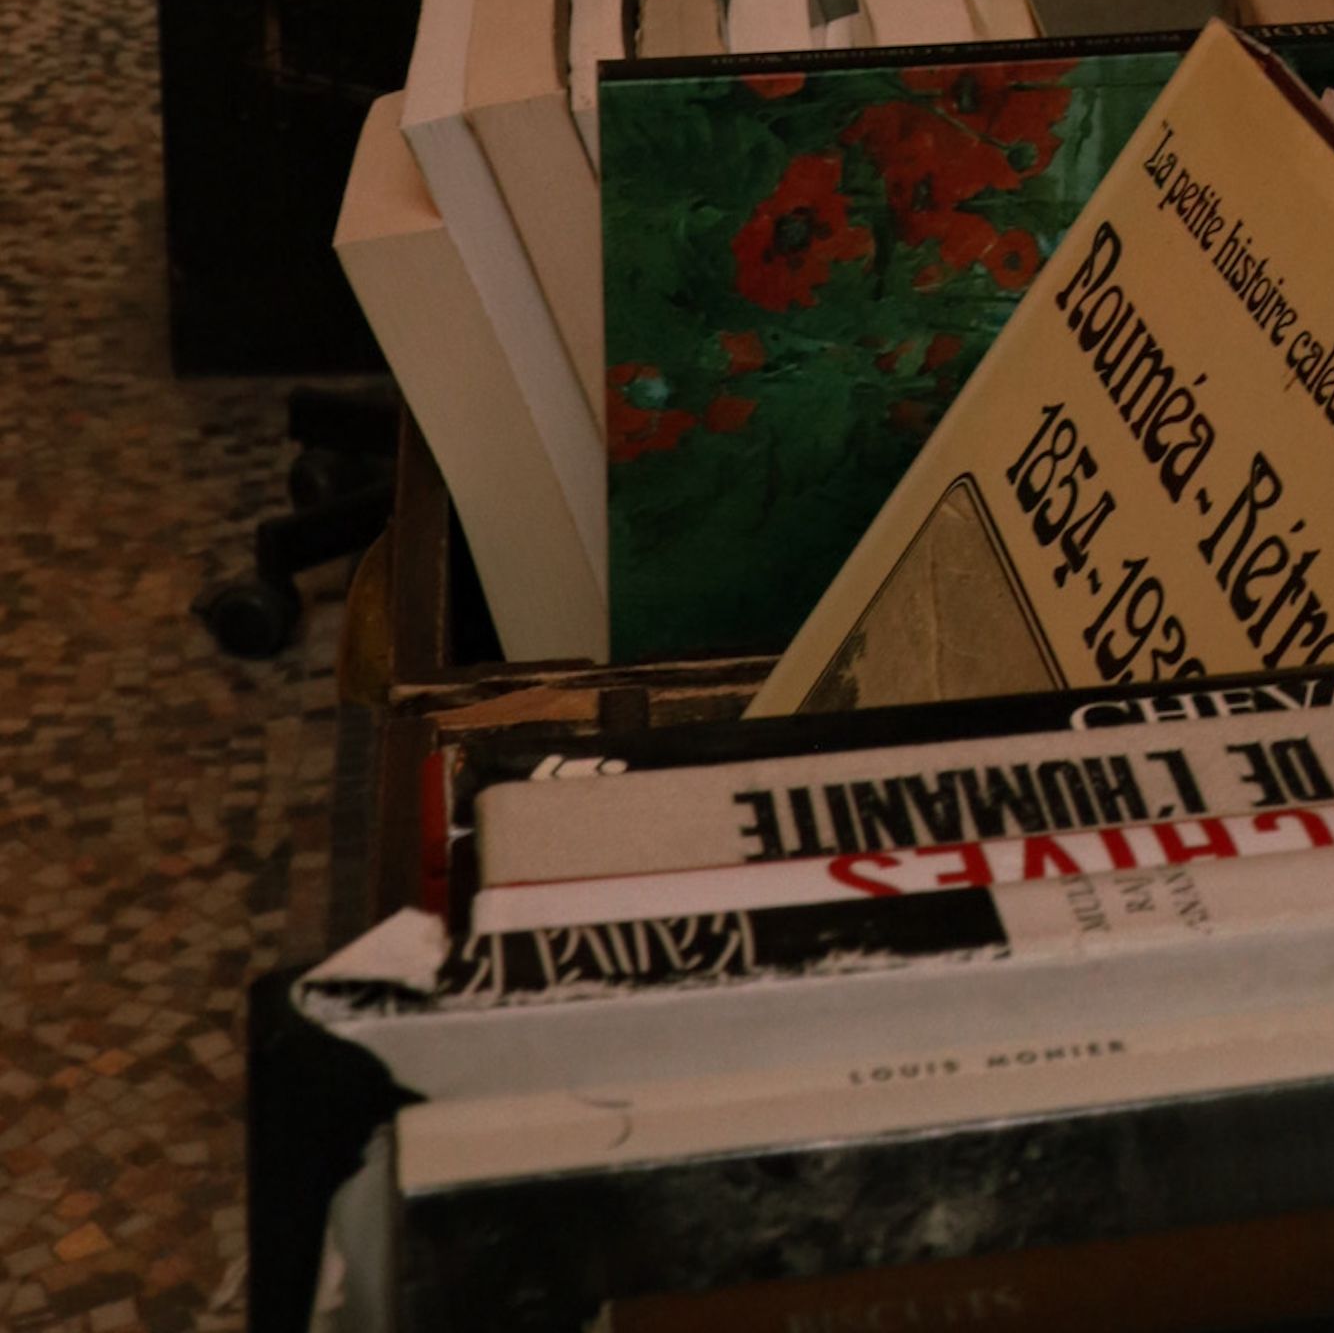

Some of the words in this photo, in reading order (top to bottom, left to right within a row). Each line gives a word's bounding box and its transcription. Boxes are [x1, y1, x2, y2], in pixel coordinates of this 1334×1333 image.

[1158, 169, 1223, 251] petite
[1212, 222, 1293, 348] histoire
[733, 750, 1209, 861] L'HUMANITE
[848, 1059, 961, 1085] LOUIS
